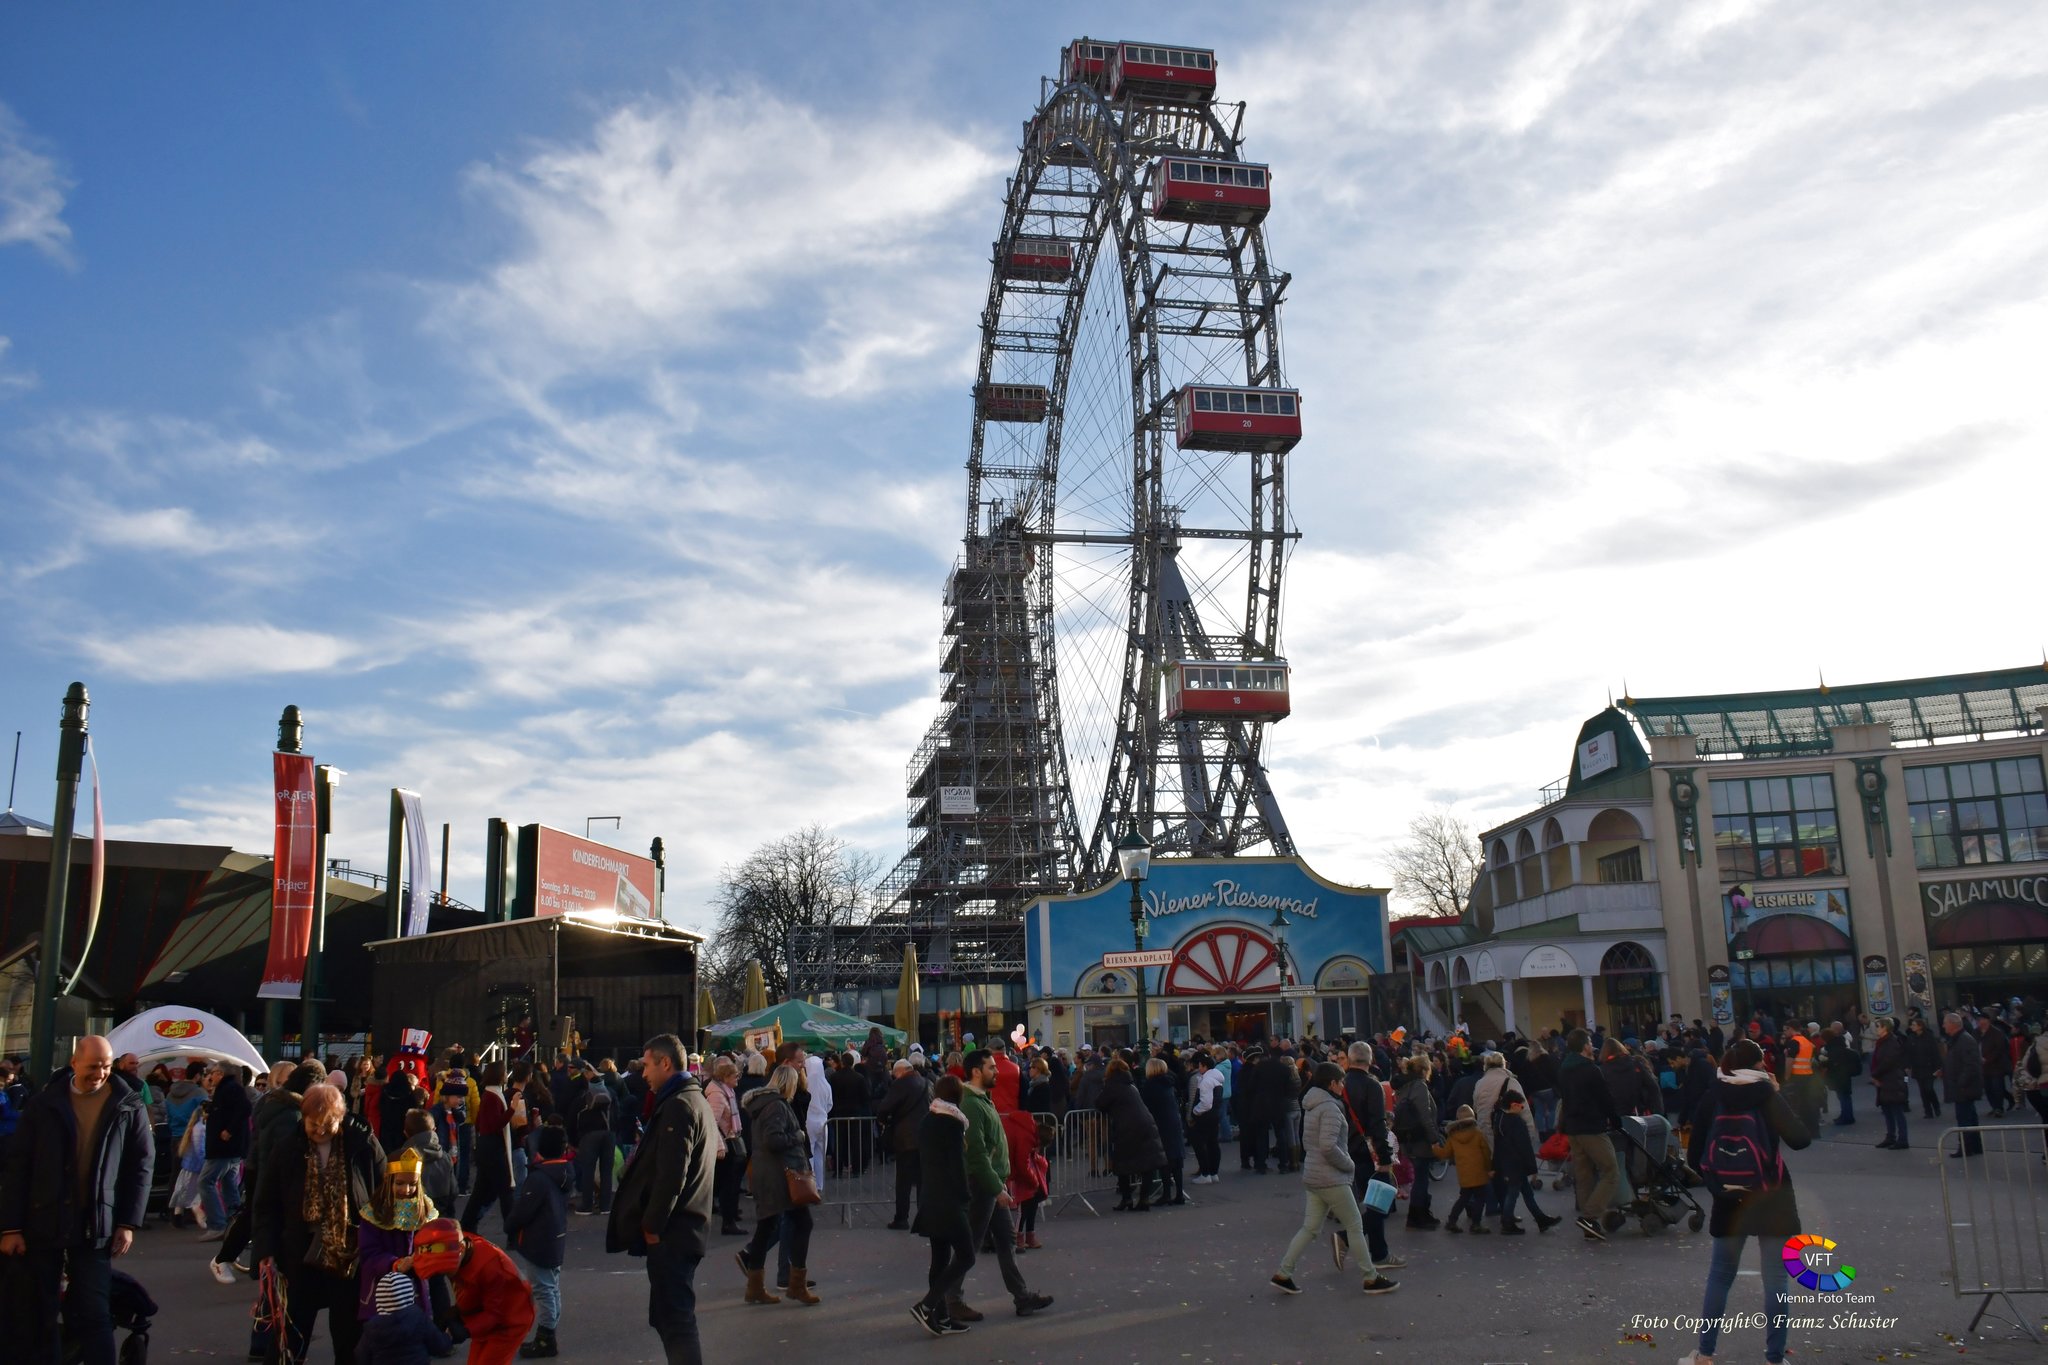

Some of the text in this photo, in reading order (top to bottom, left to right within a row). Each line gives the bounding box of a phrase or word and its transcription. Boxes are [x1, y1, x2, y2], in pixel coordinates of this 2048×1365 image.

[1243, 419, 1251, 428] 20
[1233, 696, 1240, 704] 18
[276, 789, 314, 803] PRATER
[572, 848, 629, 877] KINDERFLOHMARKT
[276, 878, 309, 891] Prater
[1212, 879, 1318, 919] Riesenrad
[1754, 893, 1817, 908] EISMEHR
[1106, 953, 1172, 964] RIESENRADPLATZ
